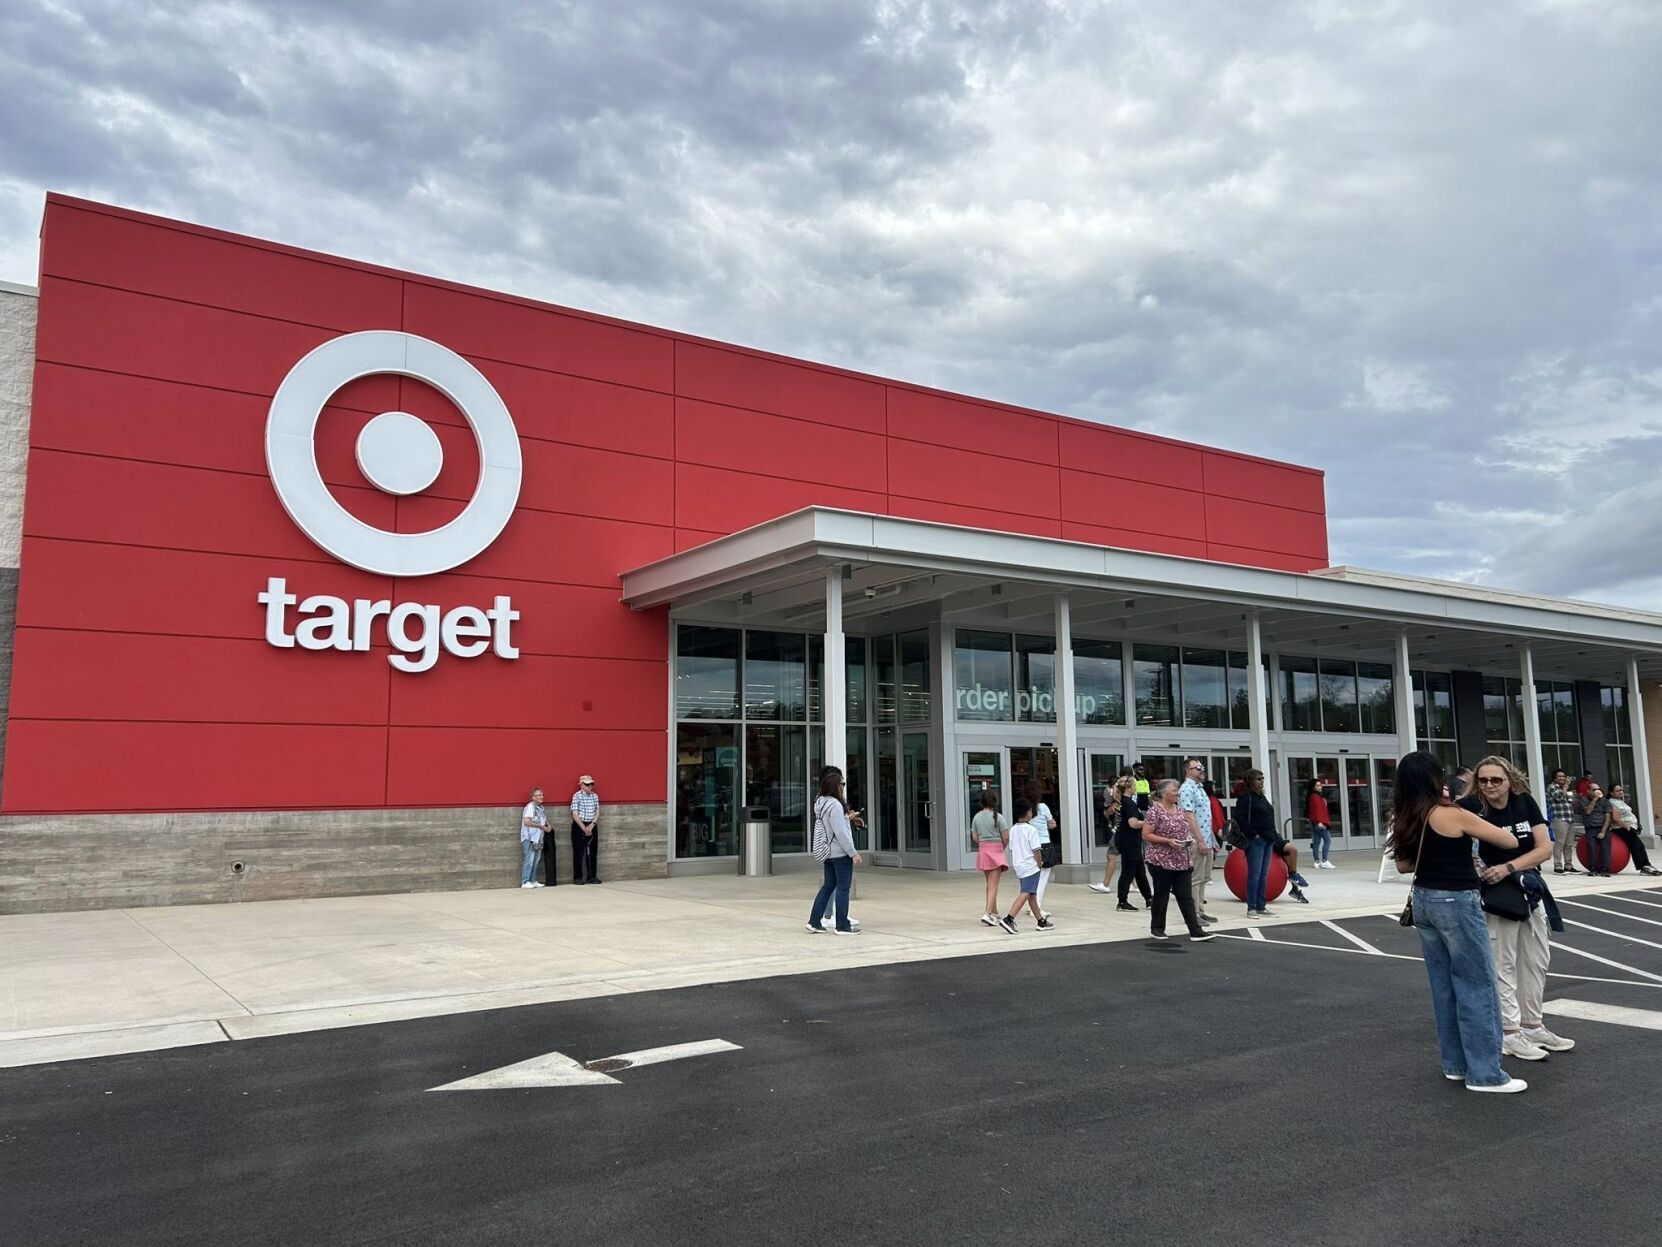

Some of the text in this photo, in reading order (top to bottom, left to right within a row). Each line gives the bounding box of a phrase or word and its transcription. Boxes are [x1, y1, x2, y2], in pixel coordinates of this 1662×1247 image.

[257, 577, 520, 673] target
[955, 683, 1009, 711] rder
[691, 822, 709, 841] BIG
